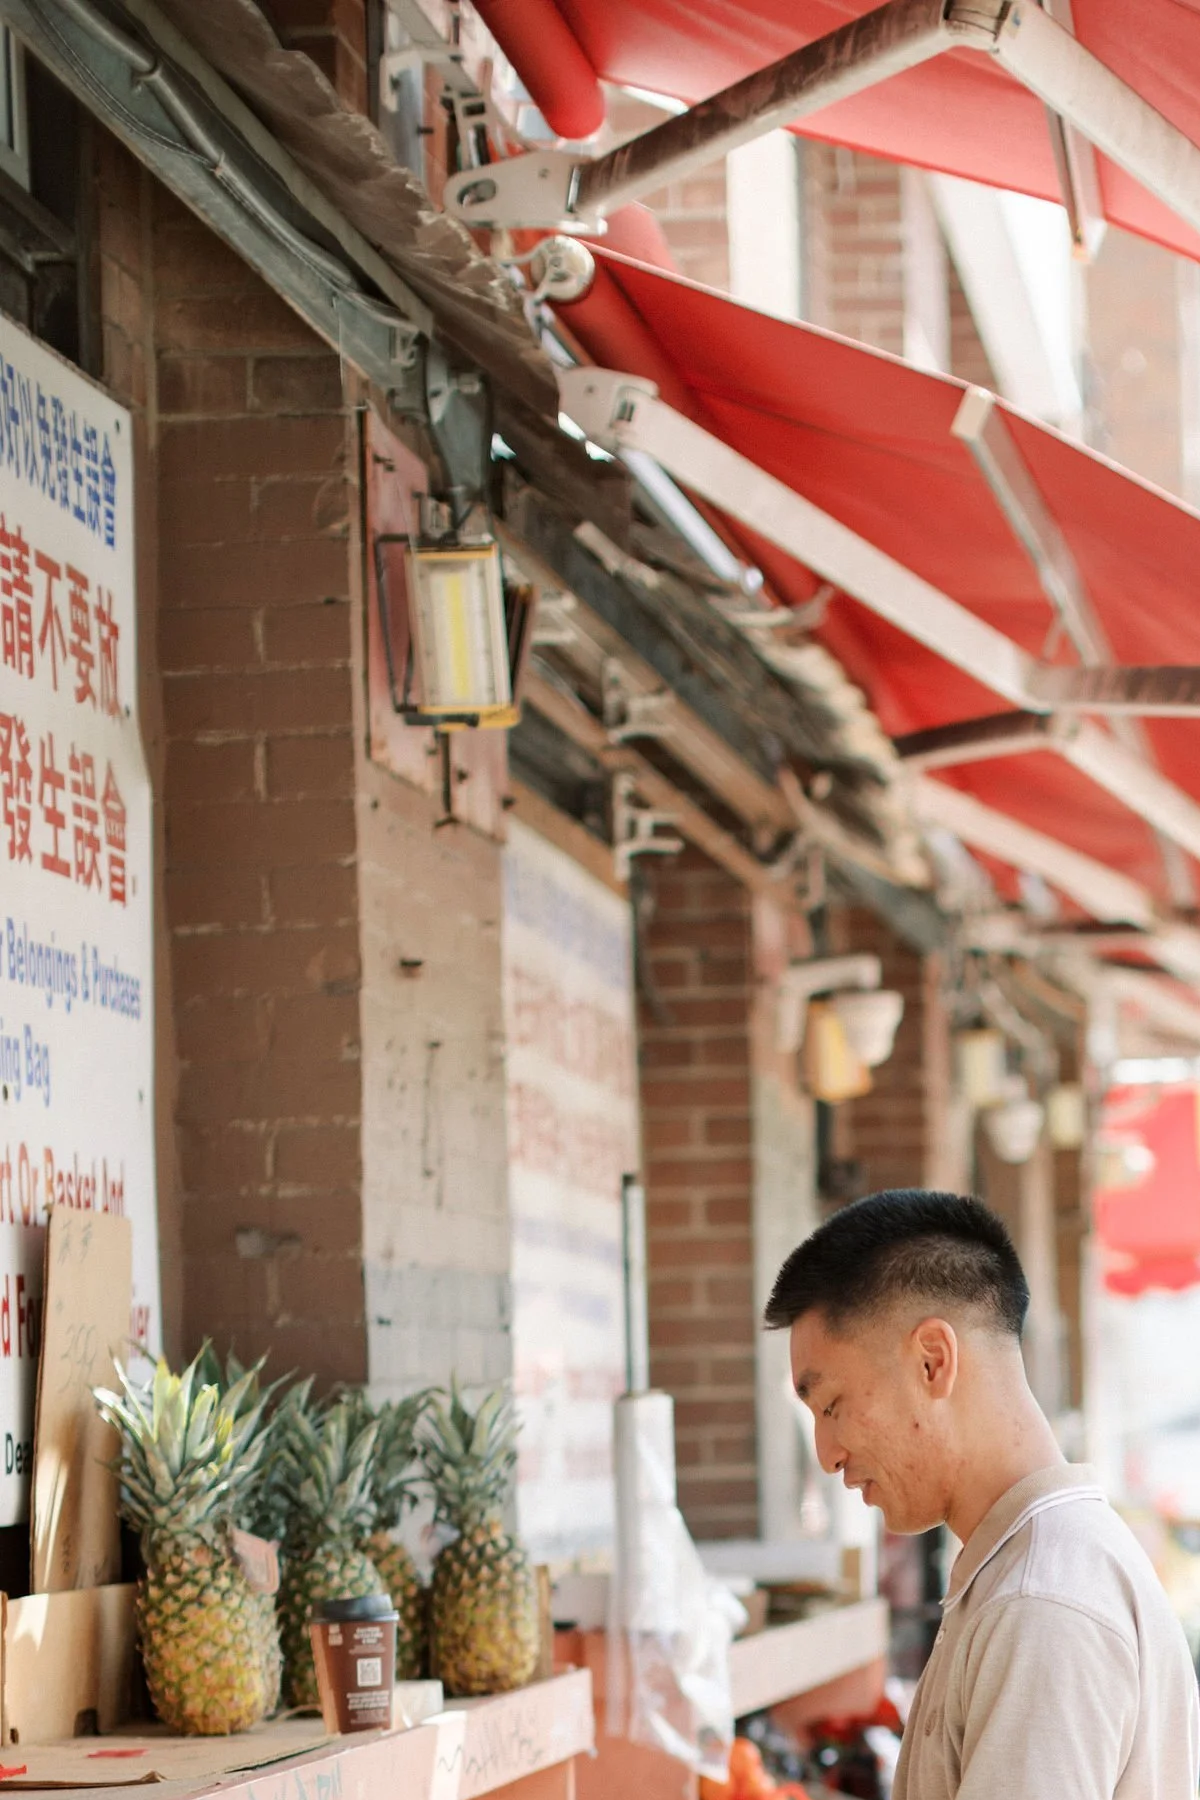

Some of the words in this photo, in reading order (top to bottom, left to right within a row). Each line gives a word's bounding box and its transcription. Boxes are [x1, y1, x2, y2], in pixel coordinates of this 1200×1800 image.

[7, 917, 77, 1013] Belongings
[24, 1024, 51, 1107] Bag
[18, 1142, 38, 1228] Or
